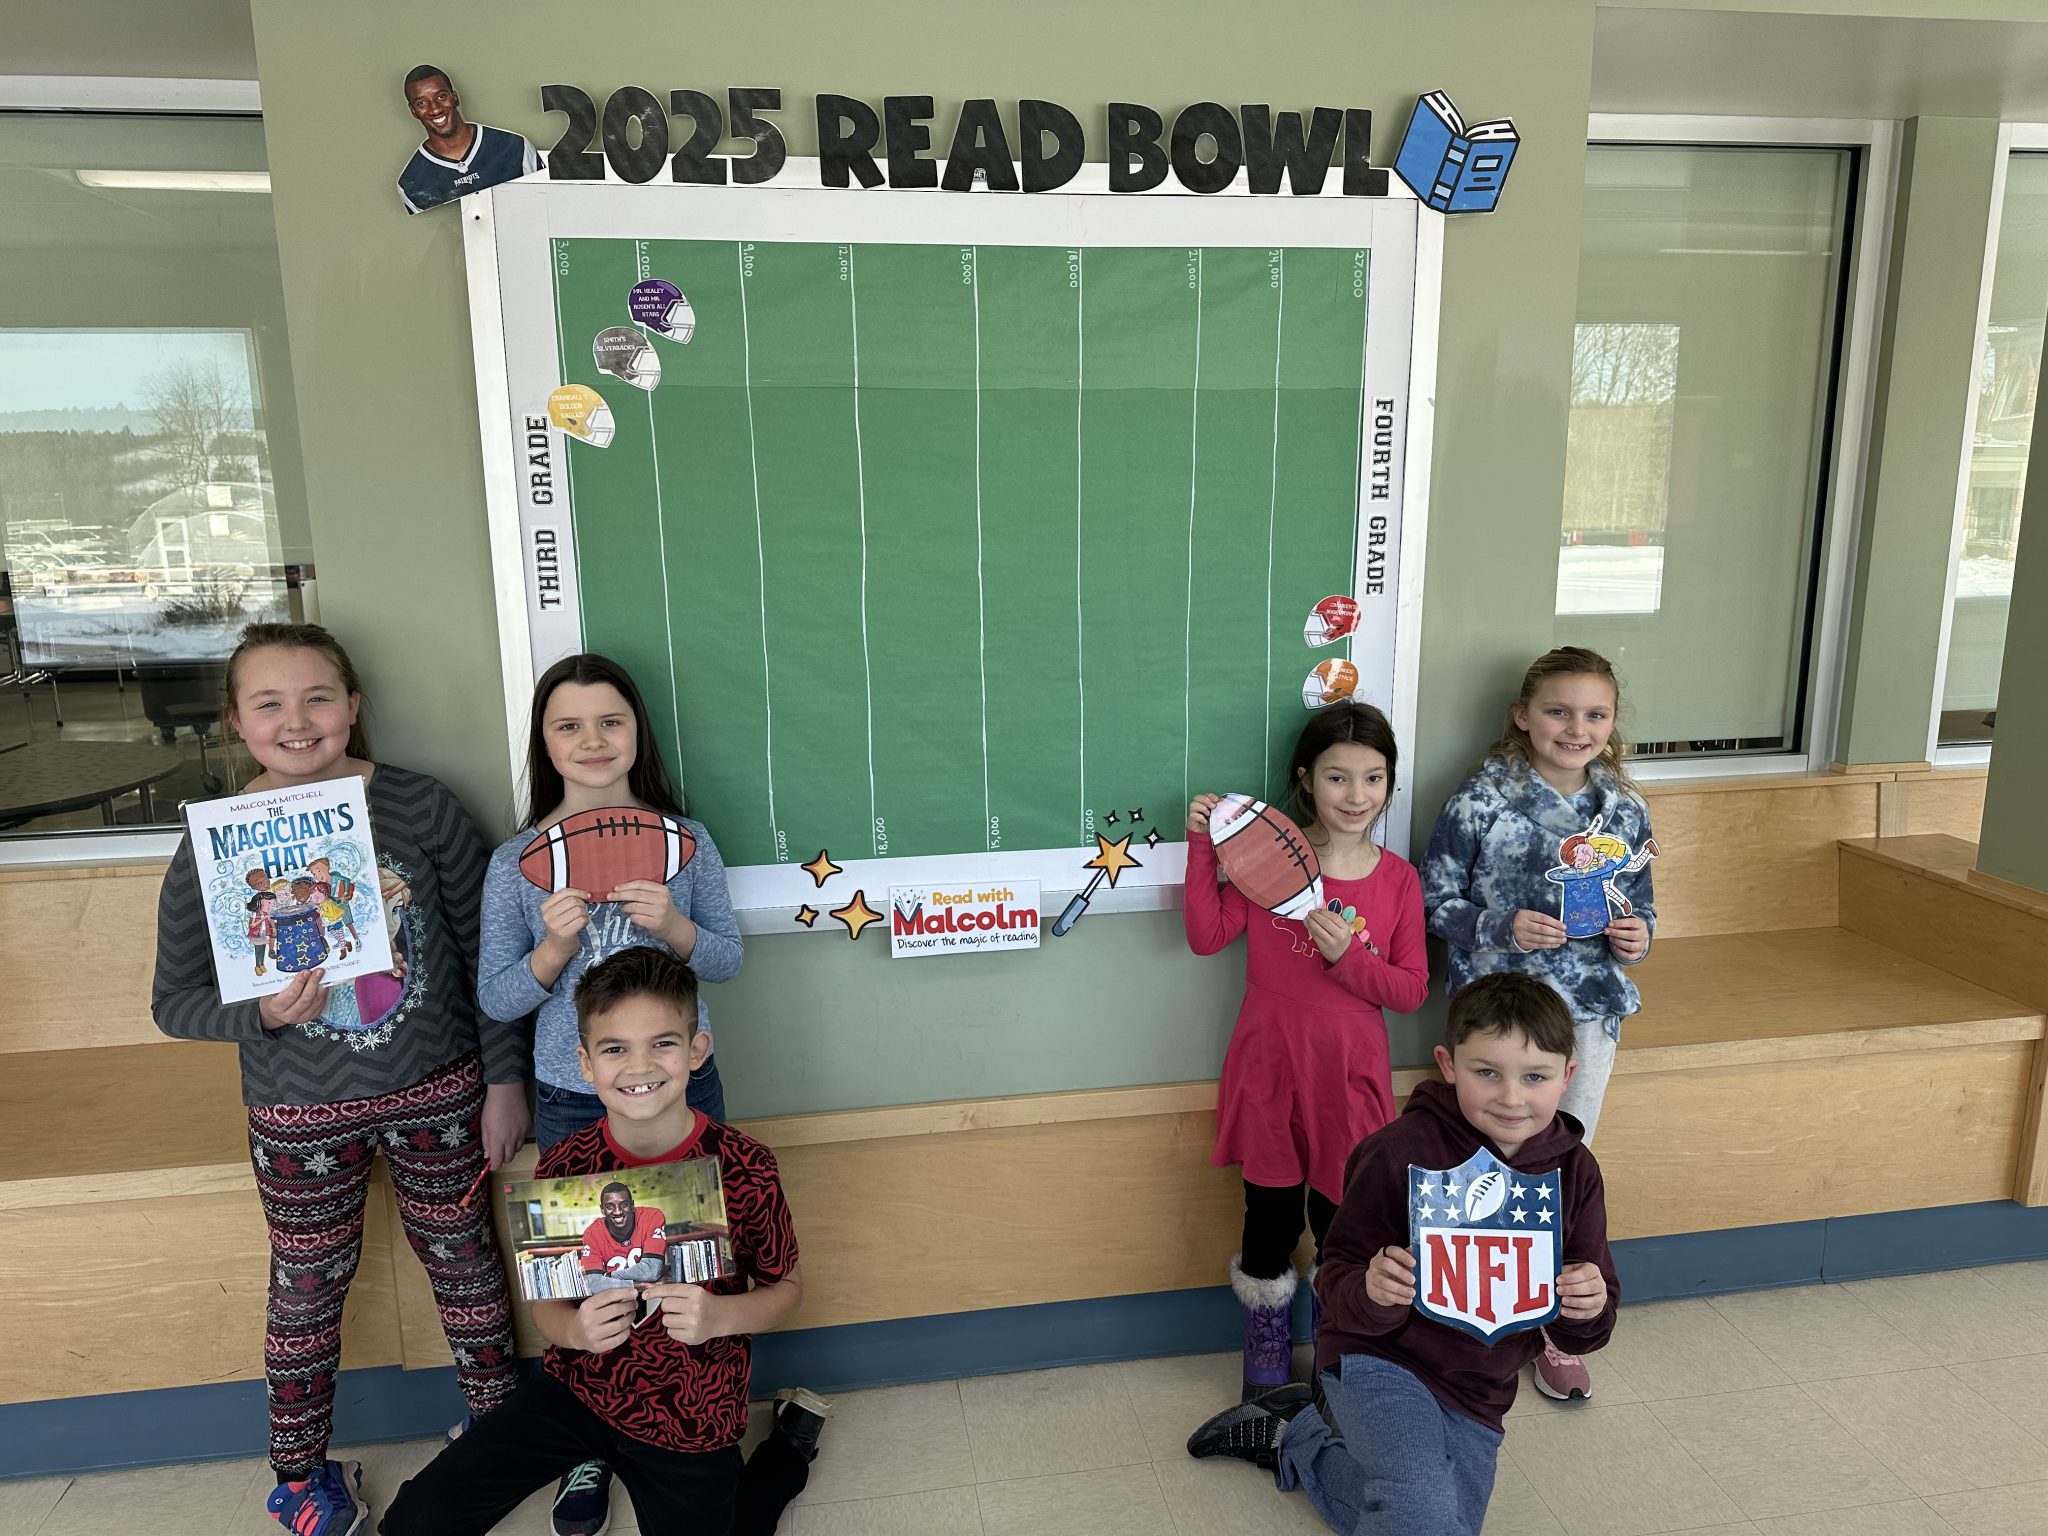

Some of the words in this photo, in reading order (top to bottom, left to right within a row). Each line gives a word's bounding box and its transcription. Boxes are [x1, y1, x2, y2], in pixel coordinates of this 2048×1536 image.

[541, 84, 787, 184] 2025
[816, 94, 1086, 192] READ
[1108, 102, 1389, 196] BOWL
[453, 172, 480, 187] PATRIOTS
[557, 240, 570, 276] 3,000
[640, 241, 651, 279] 6,000
[743, 243, 755, 278] 9,000
[838, 246, 848, 281] 12,000
[960, 248, 973, 285] 15,000
[1066, 250, 1079, 288] 18,000
[1186, 249, 1199, 289] 21,000
[1267, 249, 1280, 289] 24,000
[1352, 250, 1365, 298] 27,000
[596, 344, 636, 352] SILVERBACKS
[559, 402, 583, 410] GOLDEN
[526, 415, 553, 505] GRADE
[1371, 399, 1394, 500] FOURTH
[535, 529, 561, 610] THIRD
[1364, 515, 1388, 596] GRADE
[229, 798, 278, 813] MALCOLM
[279, 789, 324, 804] MITCHELL
[266, 805, 285, 818] THE
[206, 802, 355, 861] MAGICIAN'S
[777, 830, 789, 862] 21,000
[875, 817, 888, 855] 18,000
[990, 815, 1002, 849] 15,000
[260, 842, 308, 879] HAT
[932, 889, 973, 906] Read
[977, 887, 1014, 904] with
[893, 902, 1038, 936] Malcolm
[897, 938, 938, 949] Discover
[941, 936, 957, 946] the
[959, 933, 988, 948] magic
[990, 931, 1001, 943] of
[1002, 931, 1038, 944] reading
[1426, 1234, 1549, 1324] NFL
